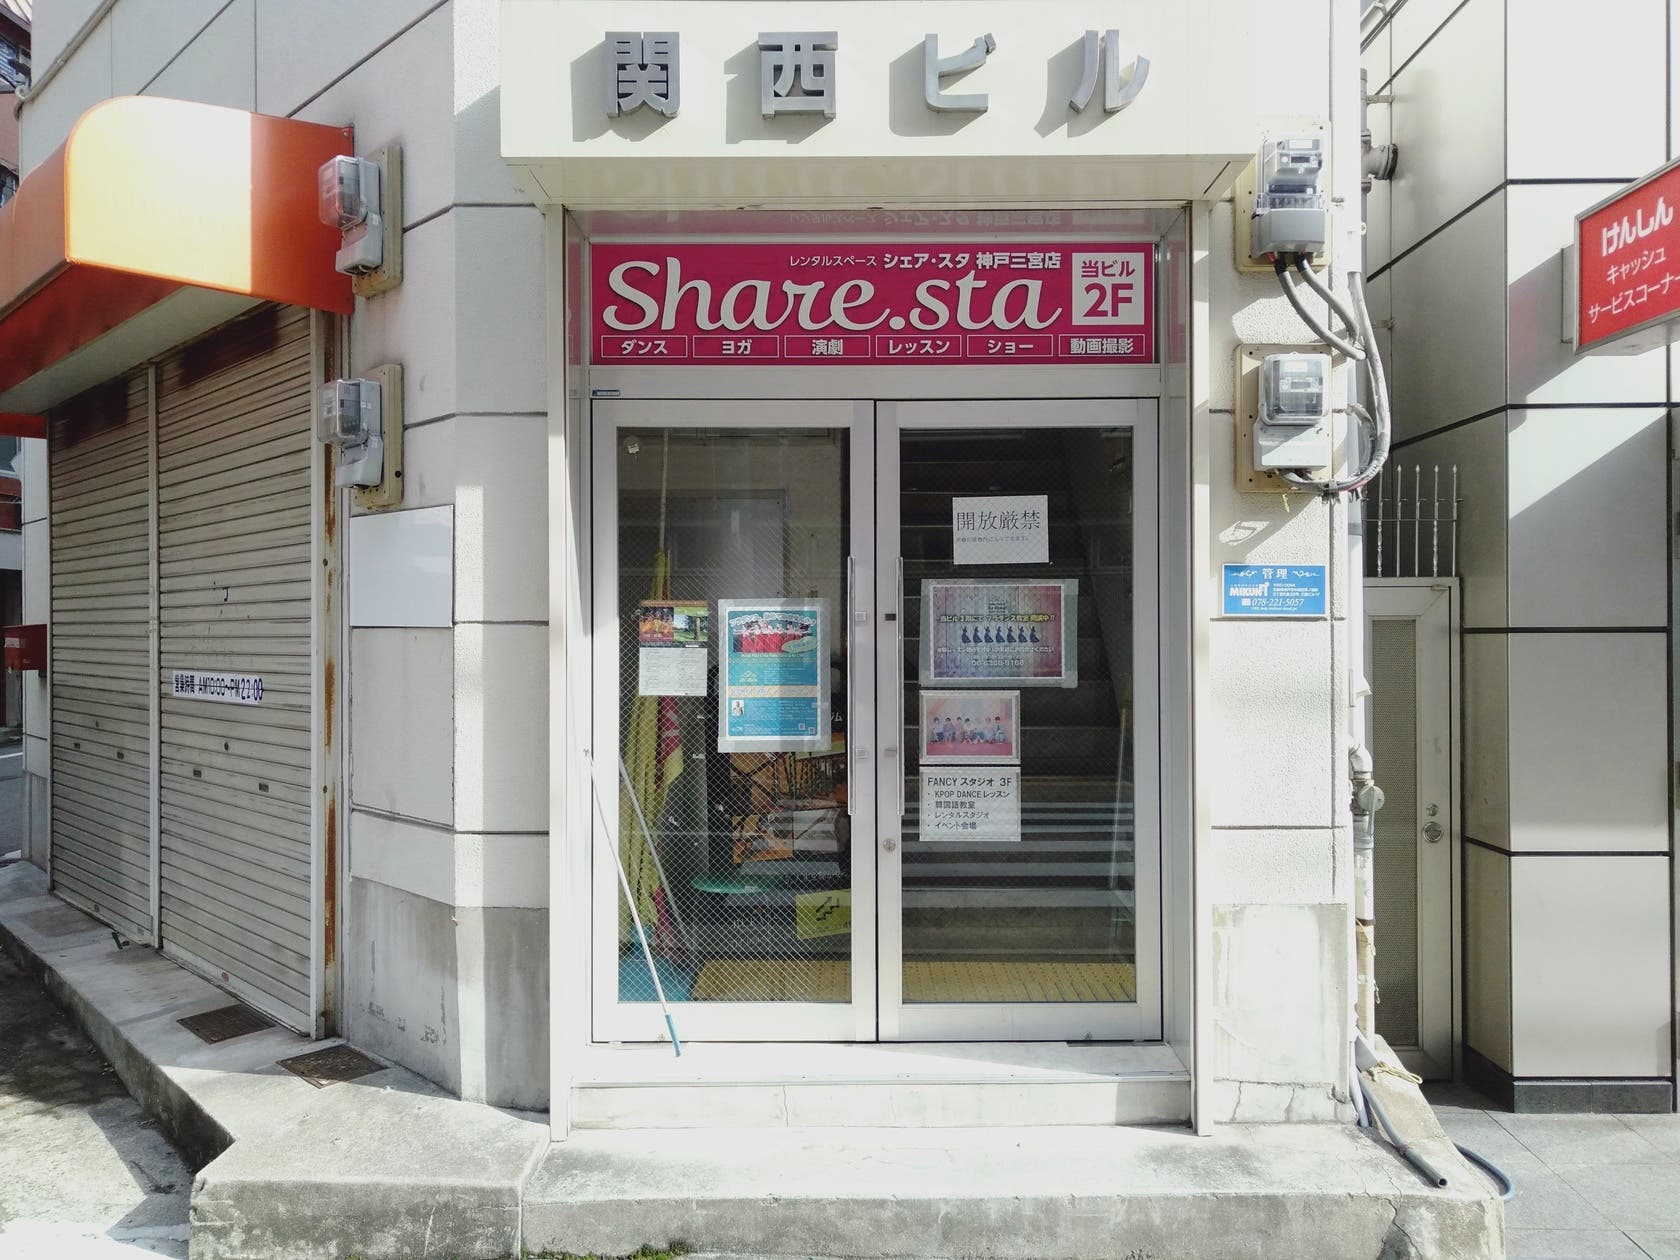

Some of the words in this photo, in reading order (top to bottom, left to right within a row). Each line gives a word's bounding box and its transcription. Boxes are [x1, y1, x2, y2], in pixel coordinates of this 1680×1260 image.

[604, 29, 1151, 120] 関西ビル
[1601, 196, 1674, 257] けんしん
[789, 255, 878, 267] レンタルスペース
[883, 252, 970, 270] シェア・スタ
[976, 251, 1062, 270] 神戸三宮店
[1080, 260, 1136, 278] 当ビル
[1606, 247, 1667, 285] キャッシュ
[602, 256, 1063, 331] Share.sta
[1082, 282, 1135, 318] 2F
[620, 338, 669, 355] ダンス
[721, 338, 753, 355] ヨガ
[811, 338, 844, 356] 演劇
[888, 339, 951, 355] レッスン
[986, 339, 1034, 355] ショー
[1069, 337, 1135, 355] 動画撮影
[956, 509, 1041, 532] 開放厳禁
[1262, 567, 1289, 580] 管理
[927, 777, 958, 787] FANCY
[960, 777, 995, 787] スタジオ
[999, 777, 1013, 787] 3F
[934, 790, 955, 799] KPOP
[935, 800, 976, 809] 韓国語教室
[934, 810, 990, 819] レンタルスタジオ
[934, 821, 977, 830] イベント会場
